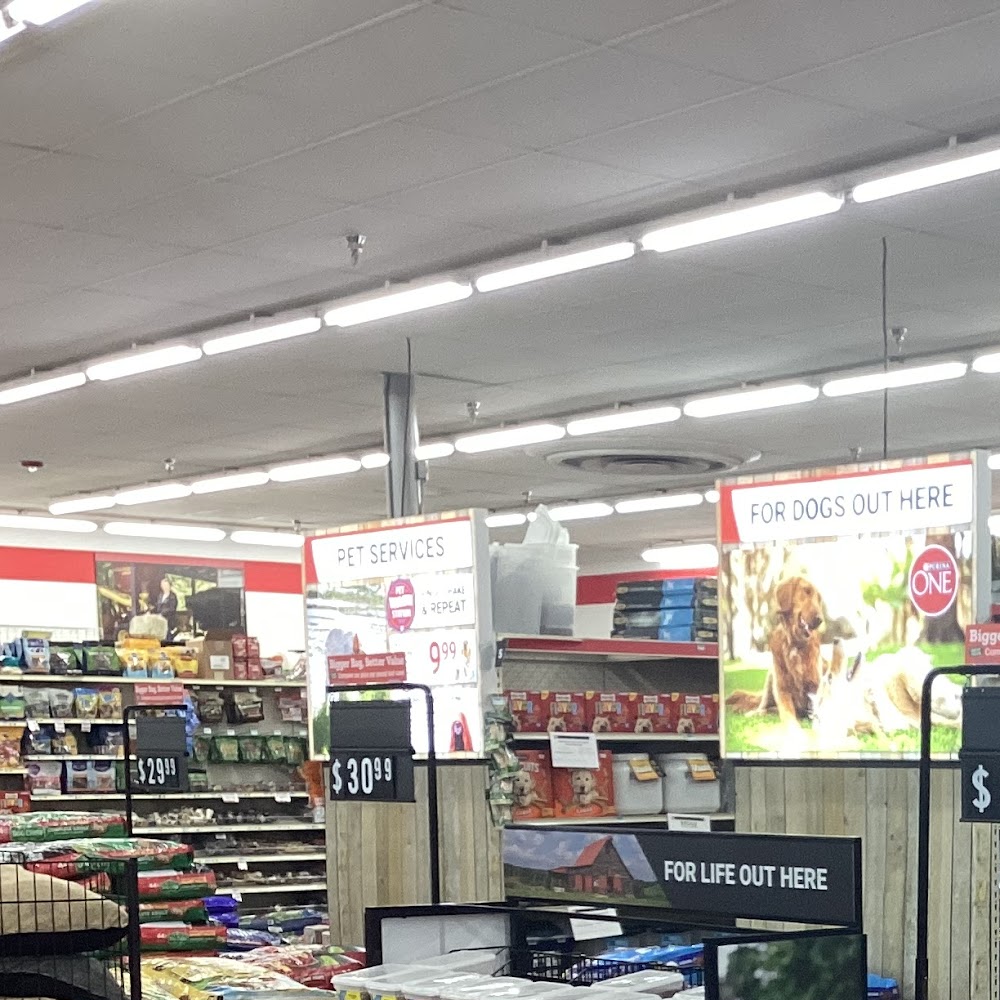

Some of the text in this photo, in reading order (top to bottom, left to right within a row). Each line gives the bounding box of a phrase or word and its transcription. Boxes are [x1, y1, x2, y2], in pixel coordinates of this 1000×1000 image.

[751, 484, 954, 524] FOR DOGS OUT HERE
[338, 536, 445, 567] PET SERVICES
[912, 570, 952, 595] ONE
[430, 600, 467, 614] REPEAT
[664, 860, 828, 891] FOR LIFE OUT HERE
